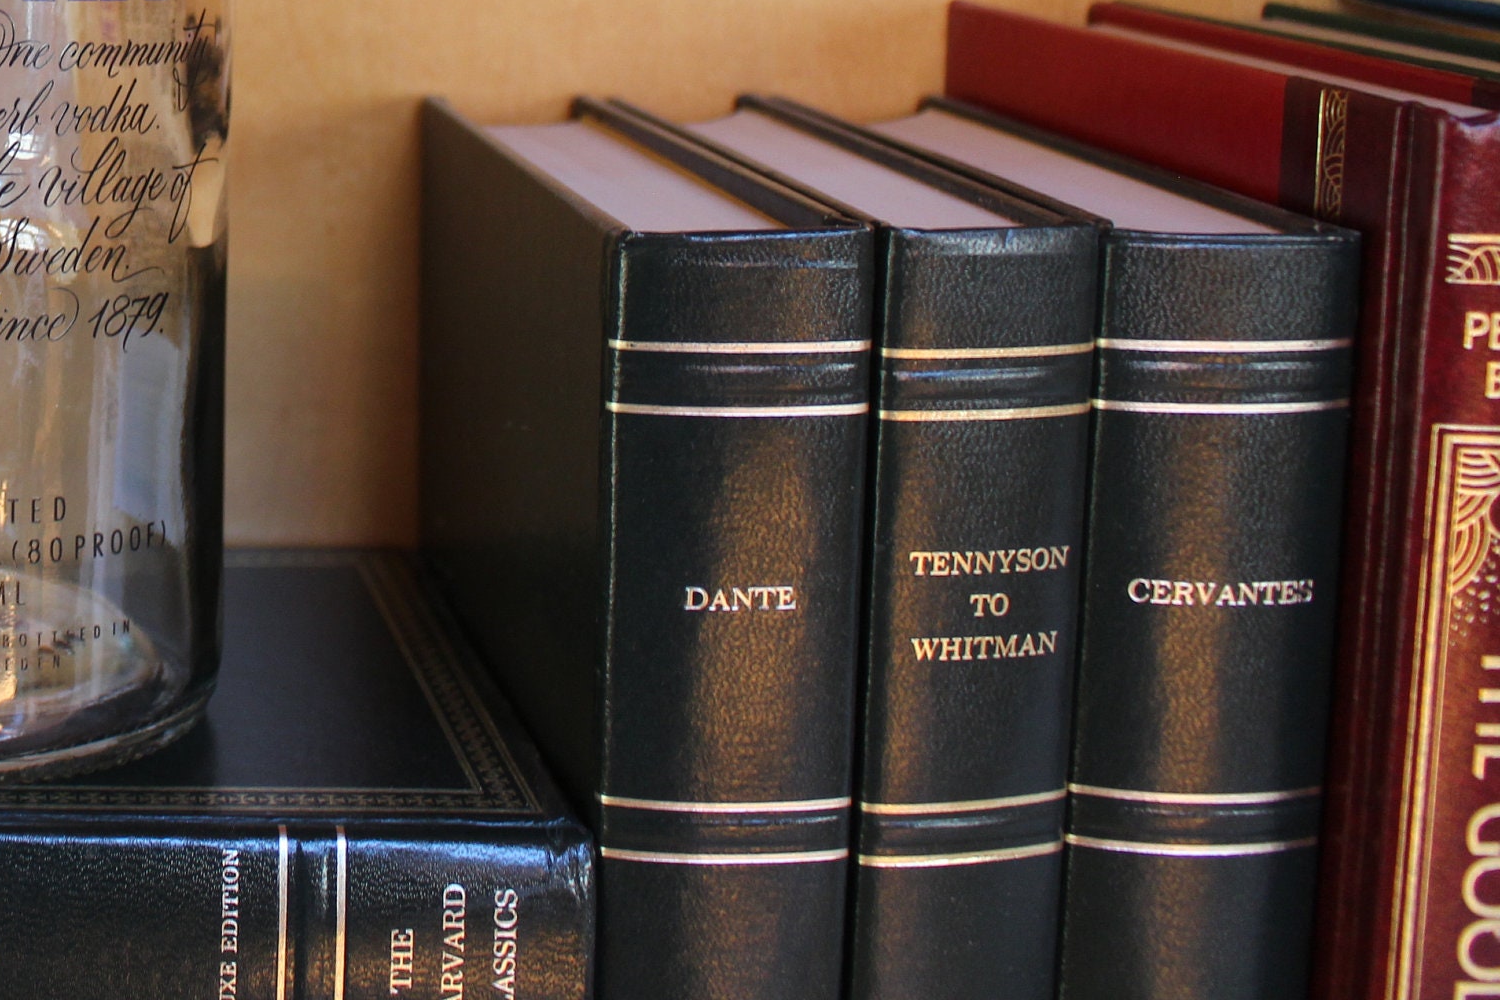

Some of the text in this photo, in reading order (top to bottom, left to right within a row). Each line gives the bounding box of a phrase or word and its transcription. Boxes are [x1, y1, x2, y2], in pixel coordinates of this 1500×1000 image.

[51, 78, 160, 136] vodka.
[170, 143, 219, 244] of
[88, 291, 169, 353] 1879.
[909, 545, 1070, 577] TENNYSON
[684, 585, 797, 612] DANTE
[970, 593, 1011, 617] TO
[1127, 578, 1314, 606] CERVANTES
[113, 620, 131, 635] IN
[910, 630, 1058, 662] WHITMAN
[221, 848, 239, 954] EDITION
[390, 928, 414, 995] THE
[491, 888, 519, 1000] ASSICS
